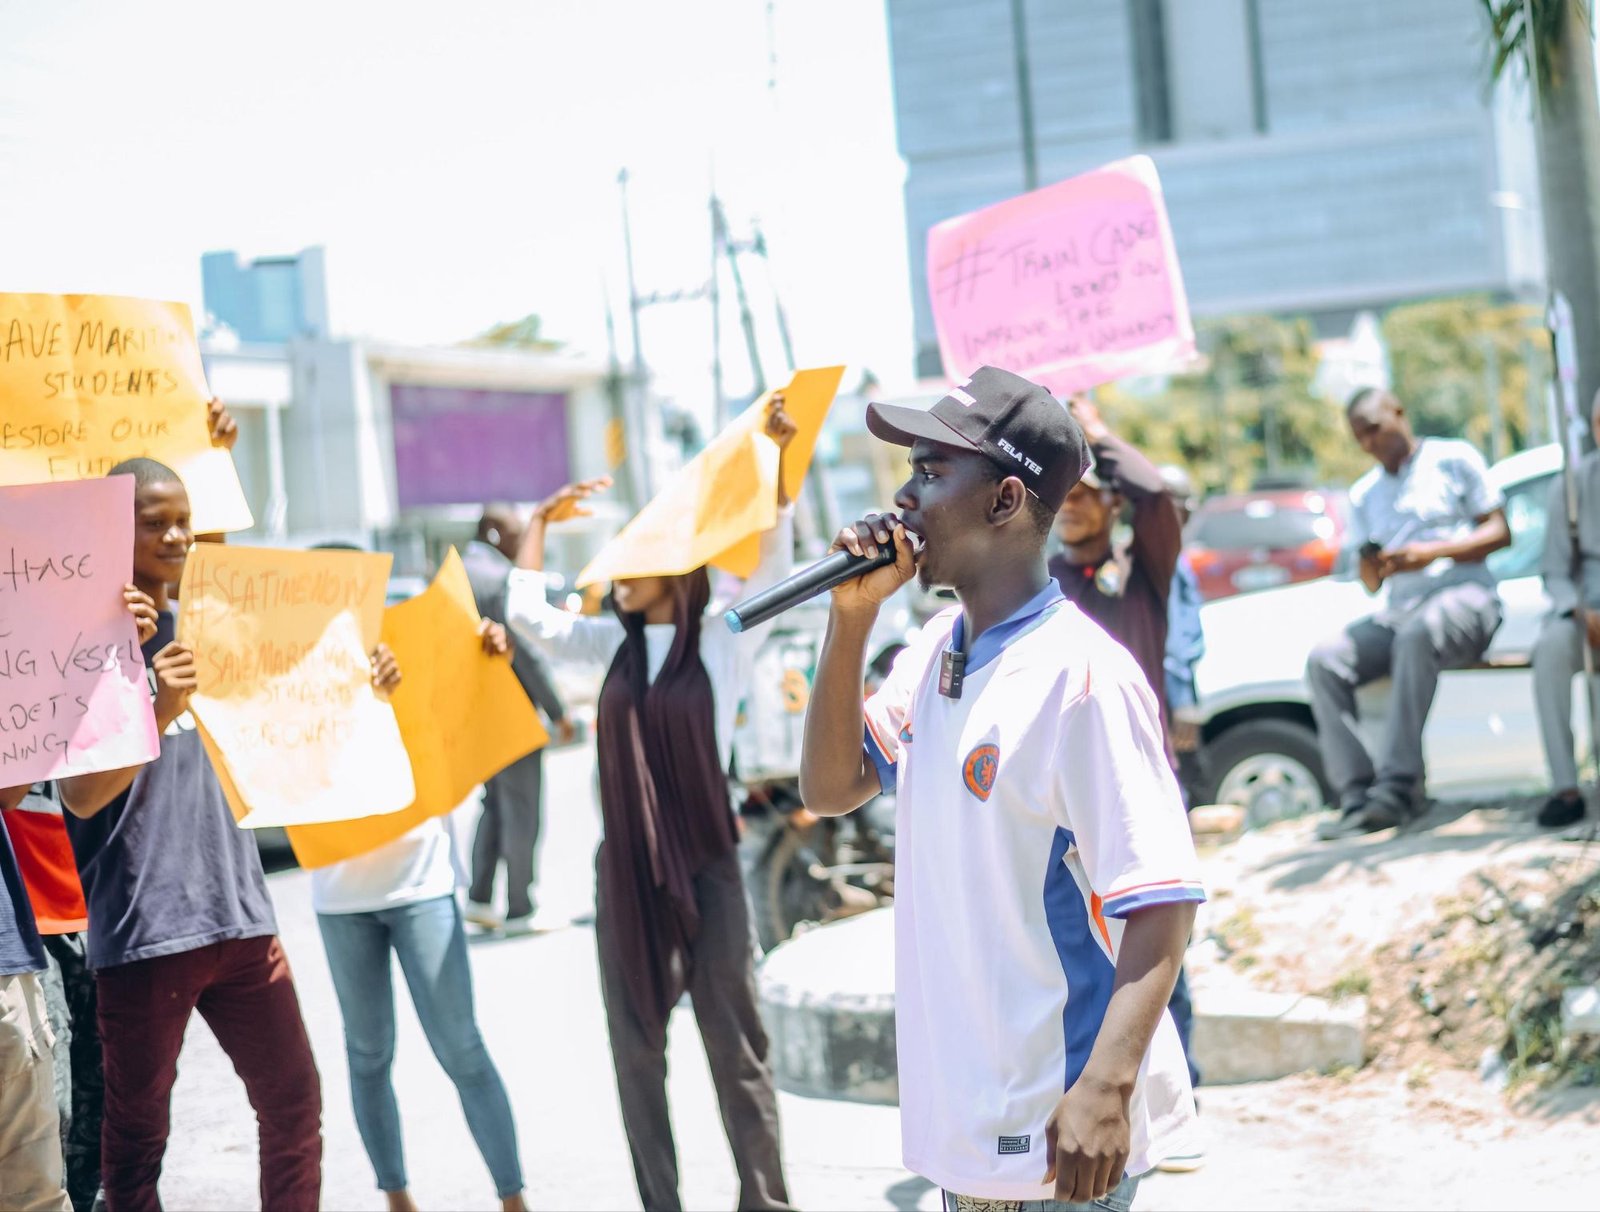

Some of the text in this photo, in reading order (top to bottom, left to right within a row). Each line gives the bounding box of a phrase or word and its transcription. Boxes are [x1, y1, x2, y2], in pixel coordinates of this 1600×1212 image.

[0, 318, 61, 362] AVE
[44, 367, 178, 399] STUDENTS
[0, 417, 170, 449] ESTORE OUR
[997, 437, 1044, 476] FELA TEE
[0, 547, 94, 592] HASE
[51, 632, 144, 679] VESSEL
